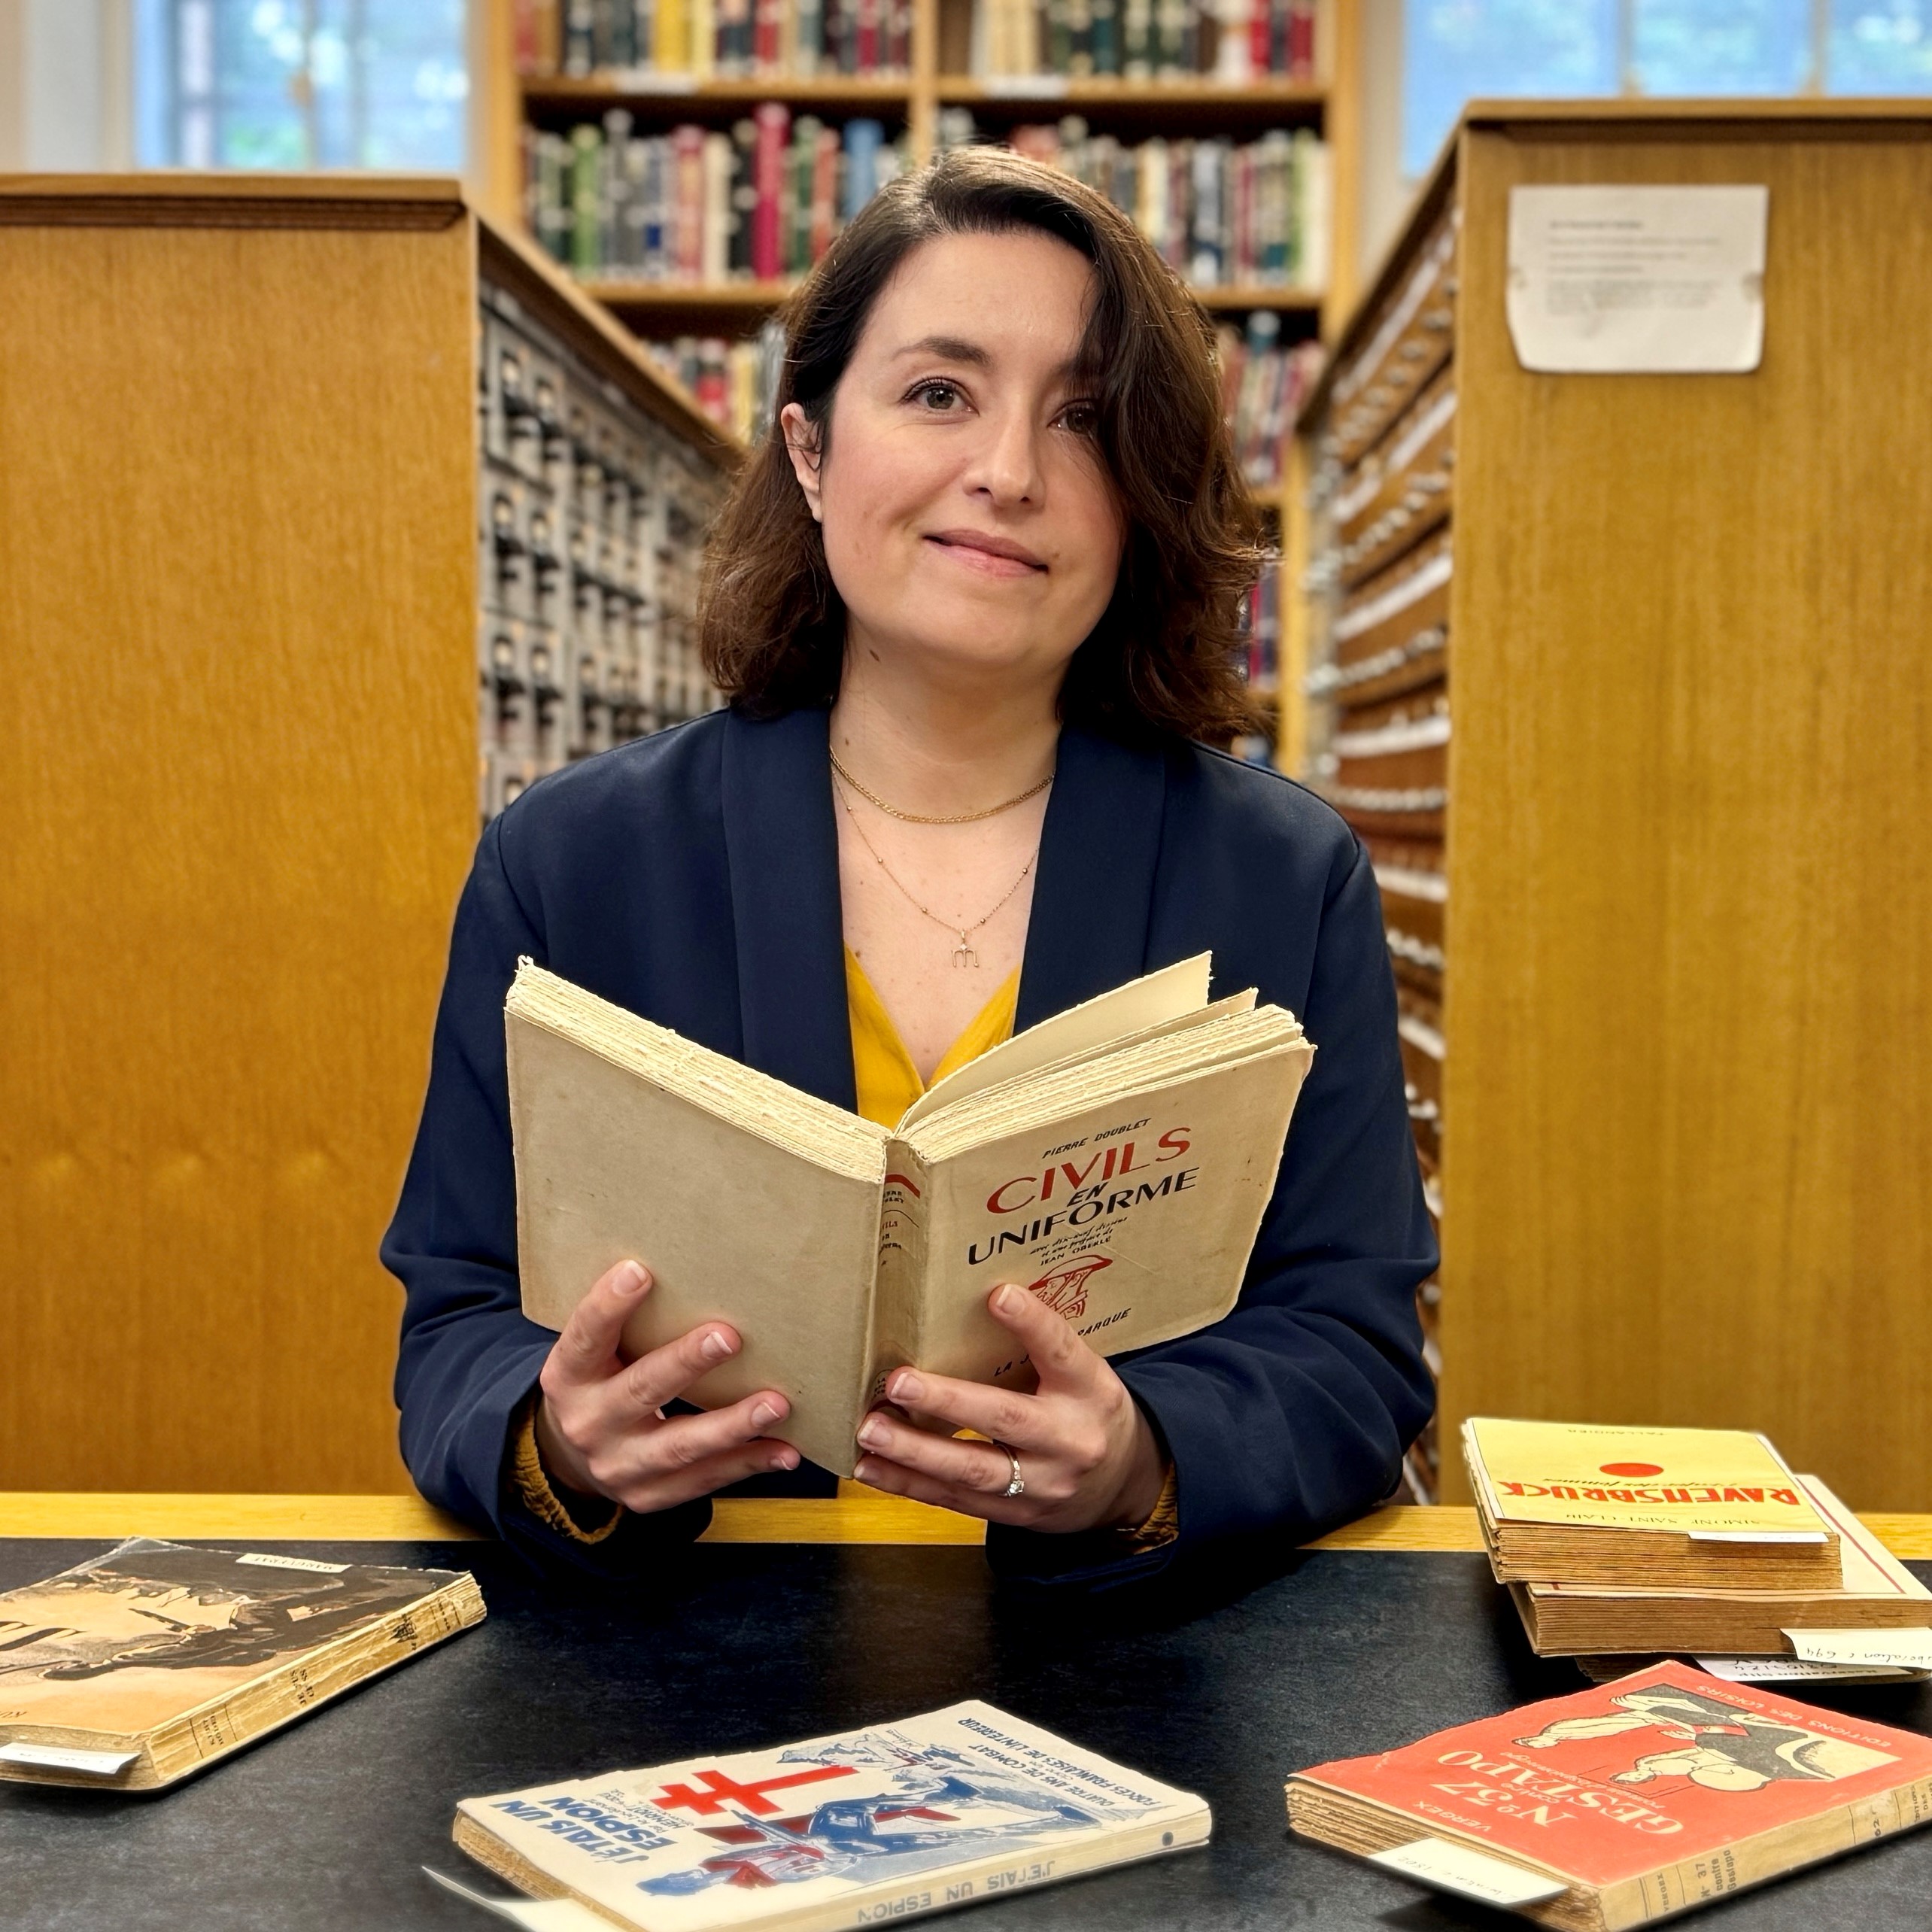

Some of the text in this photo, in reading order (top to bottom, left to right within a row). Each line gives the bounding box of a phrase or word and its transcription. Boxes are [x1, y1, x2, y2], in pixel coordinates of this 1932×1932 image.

[1042, 1118, 1153, 1159] PIERRE DOUBLET
[986, 1127, 1191, 1214] CIVILS
[1066, 1182, 1109, 1208] EN
[968, 1167, 1200, 1265] UNIFORME
[1040, 1253, 1065, 1266] JEAN
[994, 1361, 1013, 1378] LA
[1697, 1685, 1765, 1709] LOISIRS
[1769, 1708, 1803, 1721] DES
[1022, 1749, 1047, 1761] DE
[968, 1745, 1115, 1806] QUATRE ANS DE COMBAT
[1110, 1786, 1161, 1806] FORCES
[1429, 1782, 1514, 1806] 37
[1437, 1750, 1684, 1835] GESTAPO
[489, 1800, 554, 1821] UN
[1413, 1801, 1493, 1832] VERGEX
[538, 1797, 679, 1852] ESPION
[1694, 1863, 1708, 1879] 37
[946, 1881, 974, 1902] UN
[858, 1892, 932, 1923] ESPION
